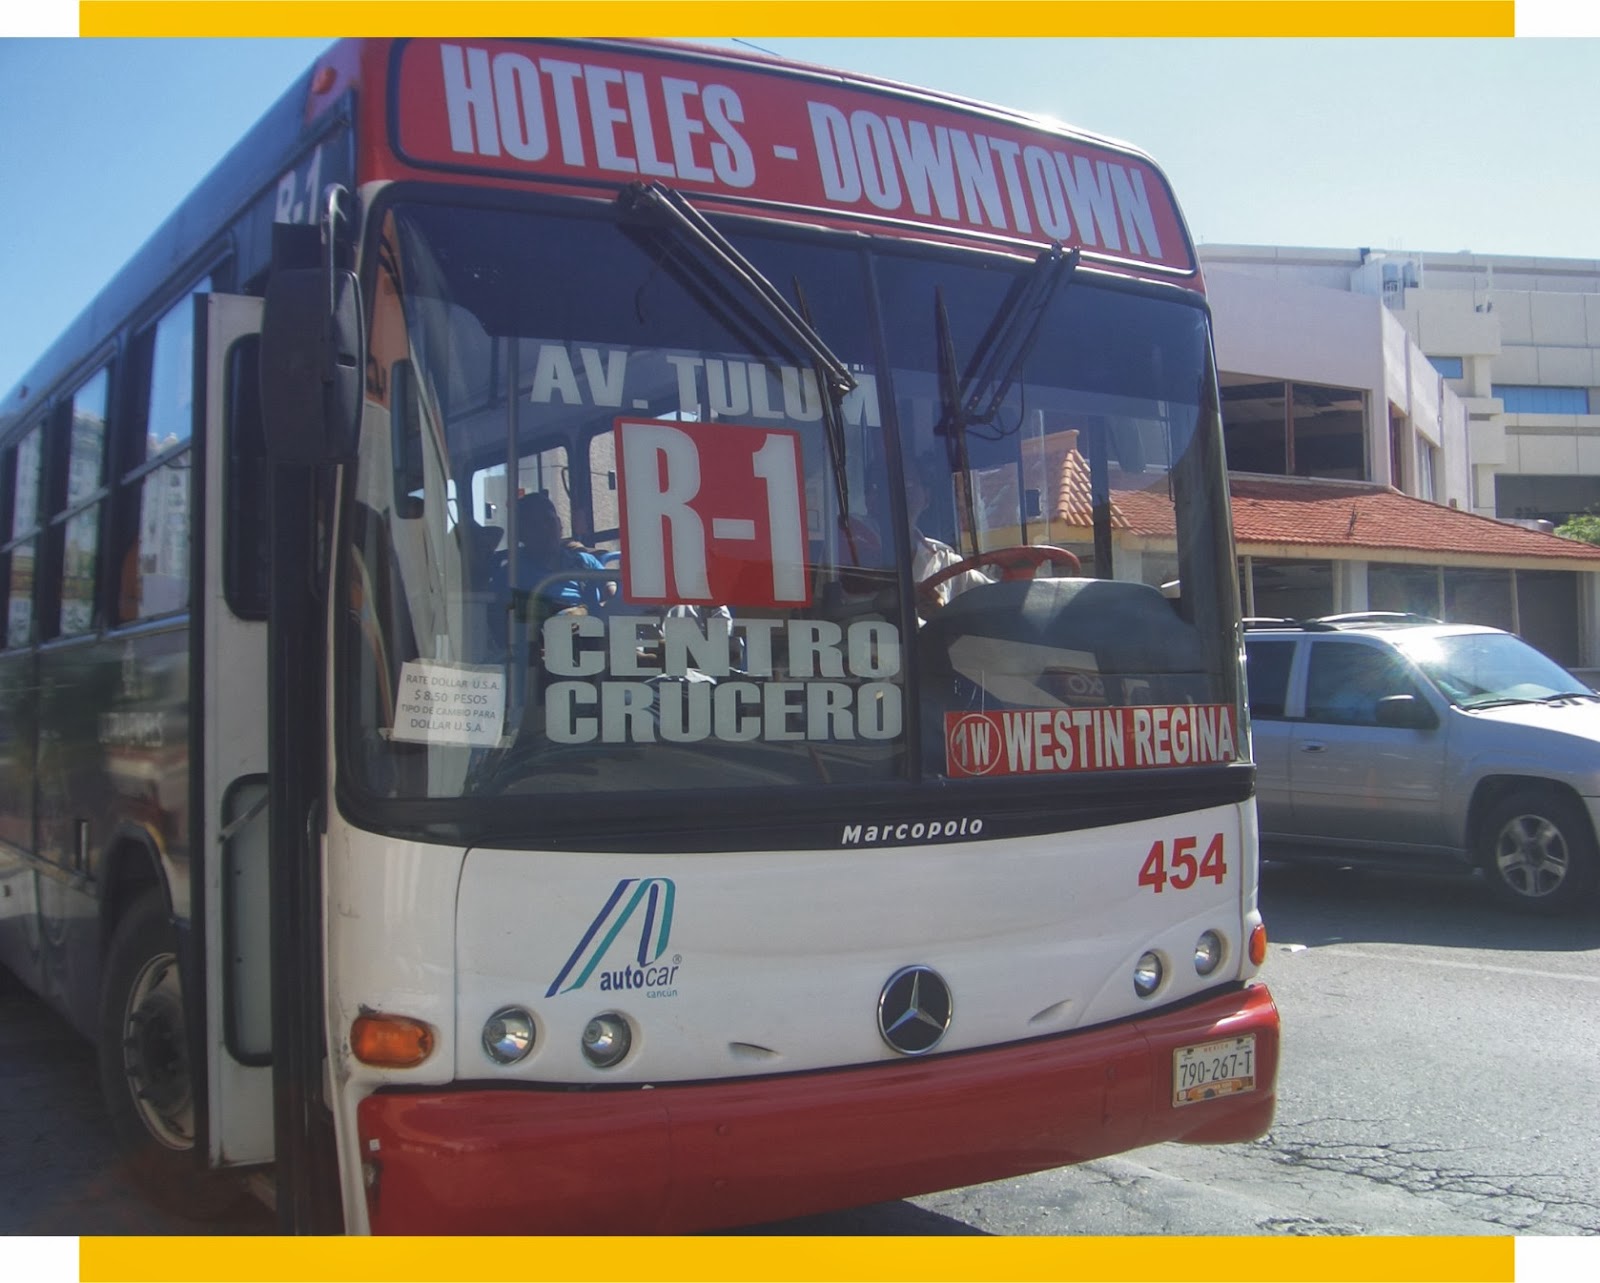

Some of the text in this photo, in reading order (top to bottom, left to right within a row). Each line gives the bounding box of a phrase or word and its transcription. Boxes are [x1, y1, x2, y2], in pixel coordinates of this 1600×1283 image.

[440, 43, 757, 188] HOTELES
[807, 101, 1163, 259] DOWNTOWN
[531, 345, 649, 409] AV.
[621, 423, 806, 602] R-1
[543, 615, 900, 678] CENTRO
[406, 674, 428, 685] RATE
[431, 677, 468, 688] DOLLAR
[453, 694, 488, 704] PESOS
[402, 704, 420, 713] TIPO
[422, 706, 434, 714] DE
[473, 710, 496, 719] PARA
[410, 719, 451, 730] DOLLAR
[545, 681, 902, 744] CRUCERO
[1003, 709, 1125, 772] WESTIN
[1133, 706, 1236, 766] REGINA
[841, 817, 983, 845] Marcopolo
[1138, 833, 1227, 893] 454
[600, 964, 679, 991] autocar
[1180, 1050, 1252, 1087] 790-267-T
